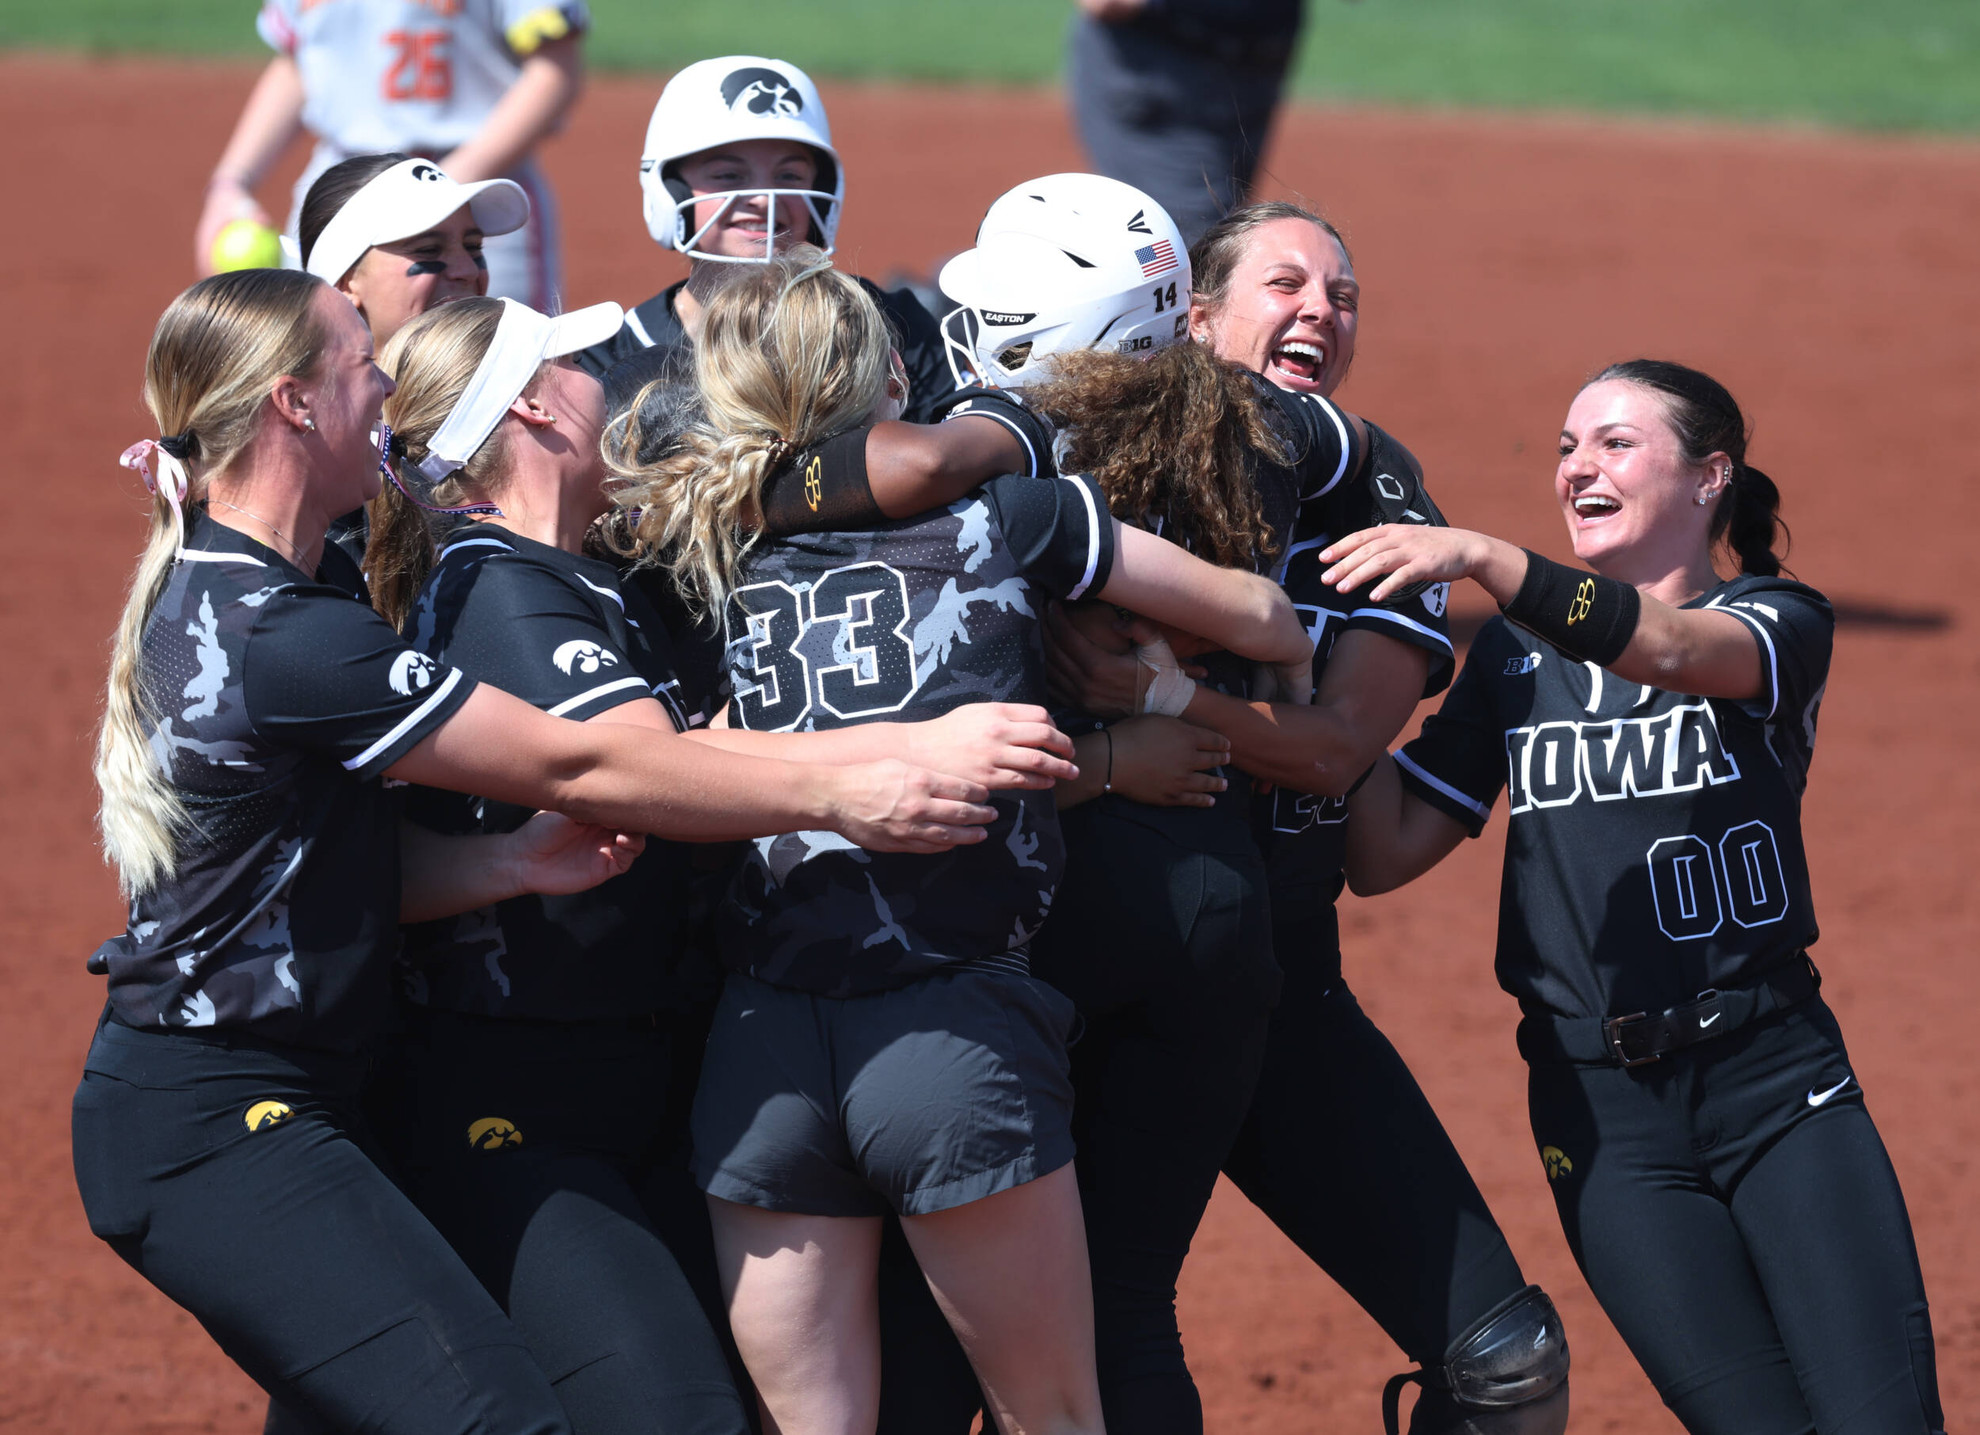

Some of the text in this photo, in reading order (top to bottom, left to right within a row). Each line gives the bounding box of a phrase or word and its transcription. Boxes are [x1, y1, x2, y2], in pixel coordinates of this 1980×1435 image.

[984, 312, 1025, 323] EASTON
[1153, 282, 1177, 313] 14
[724, 560, 918, 733] 33
[1505, 698, 1742, 815] IOWA
[1646, 819, 1789, 941] 00
